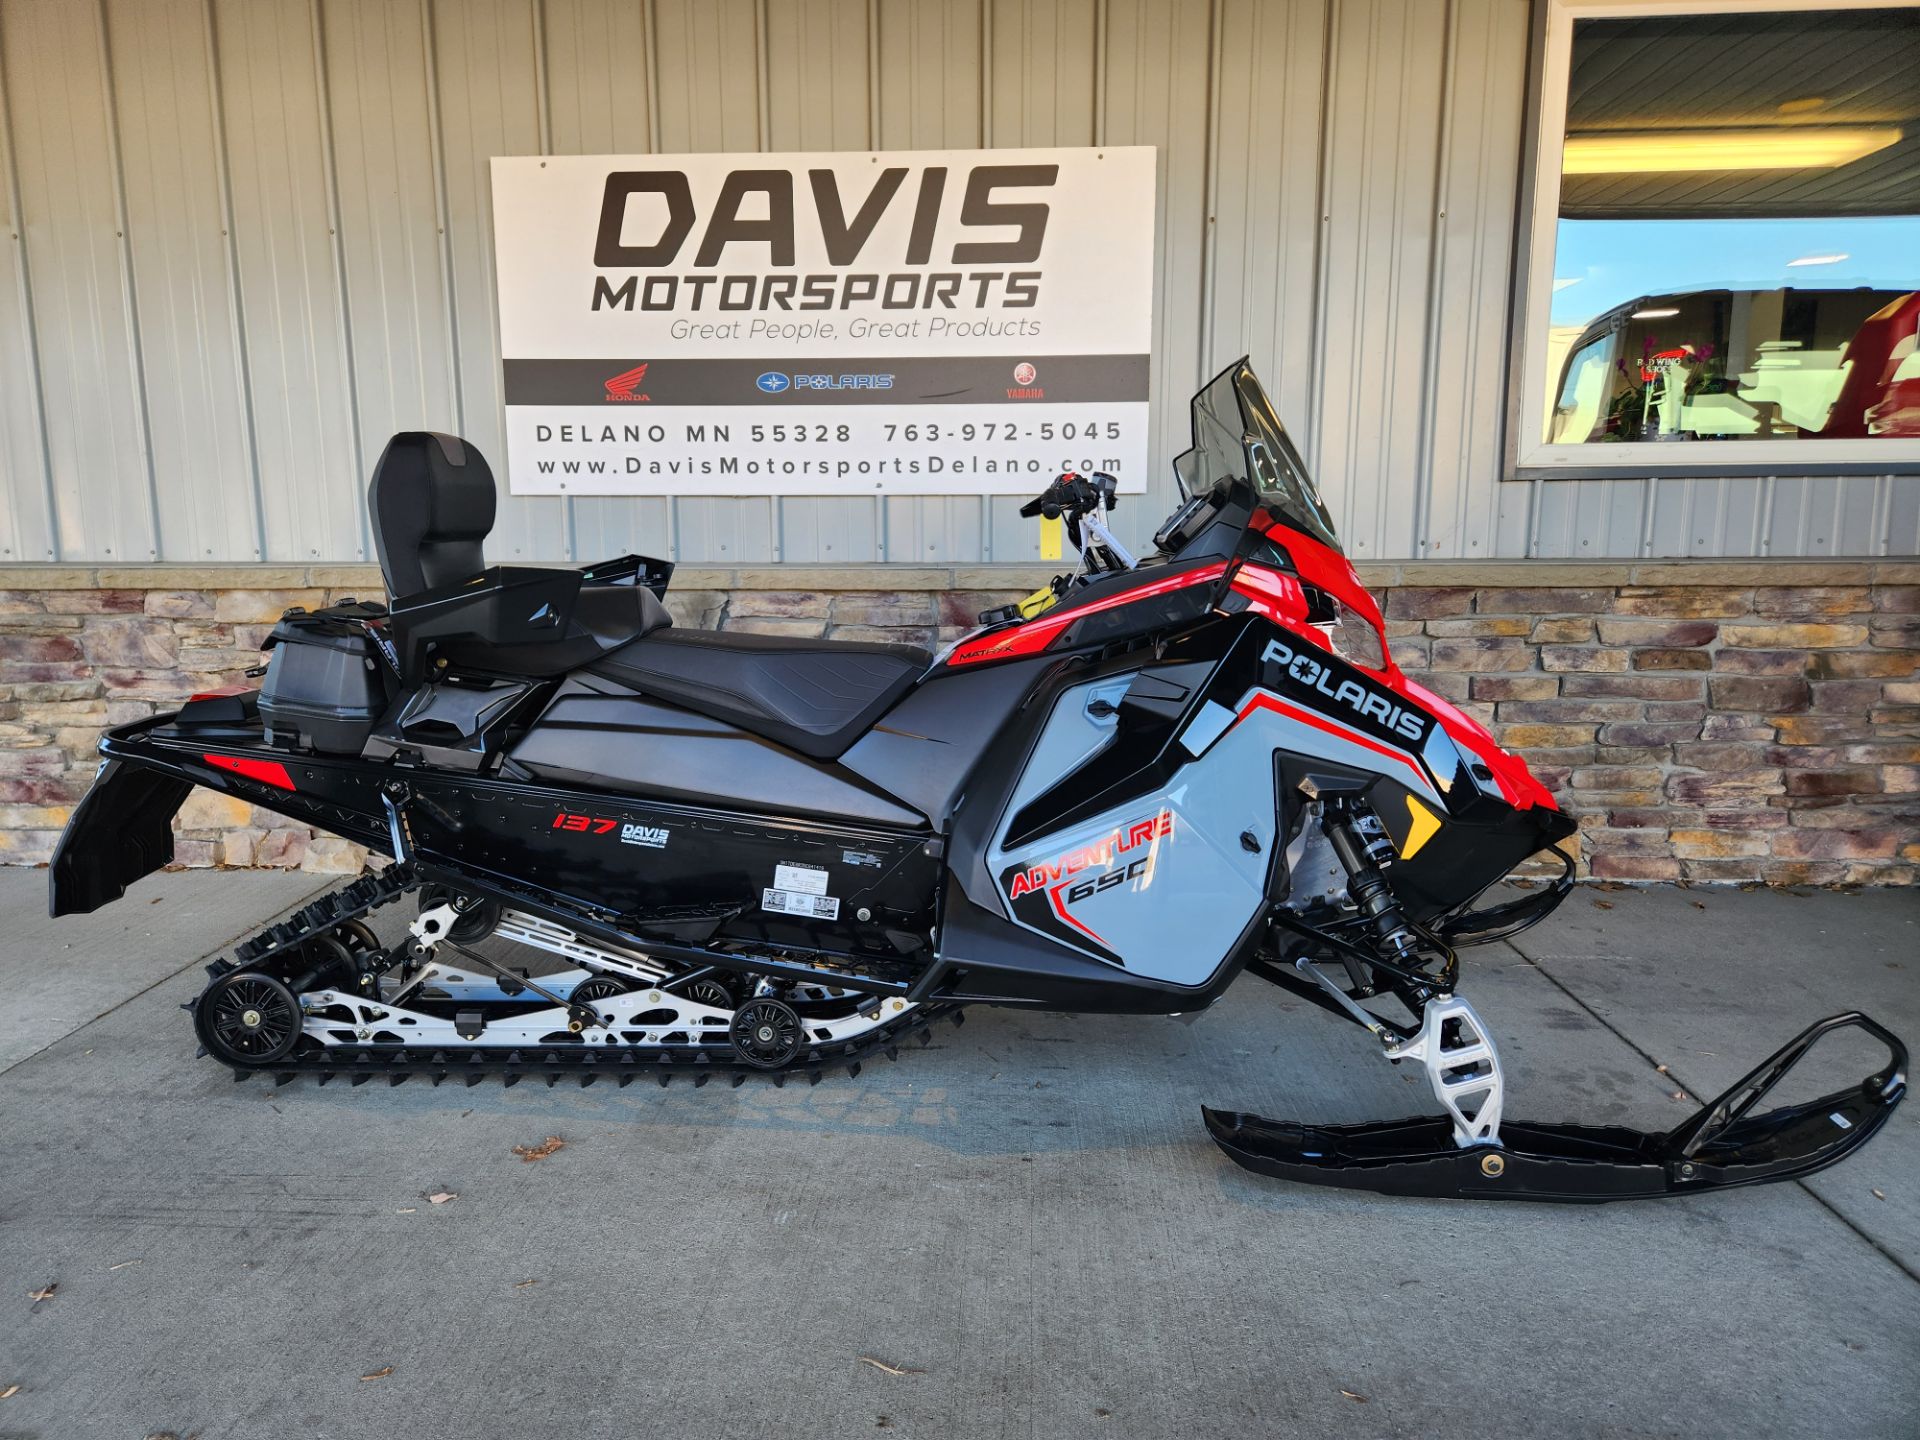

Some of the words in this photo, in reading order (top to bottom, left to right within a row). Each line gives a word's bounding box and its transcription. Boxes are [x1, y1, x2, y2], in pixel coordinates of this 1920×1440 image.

[593, 164, 1060, 268] DAVIS
[591, 271, 1043, 312] MOTORSPORTS
[670, 318, 742, 340] Great
[749, 318, 838, 344] People,
[849, 317, 921, 339] Great
[928, 316, 1041, 338] Products
[794, 374, 893, 390] POLARIS
[1007, 388, 1044, 400] YAMAHA
[536, 424, 665, 443] DELANO
[686, 424, 730, 443] MN
[751, 424, 851, 443] 55328
[883, 422, 1121, 442] 763-972-5045
[537, 455, 1121, 479] www.DavisMotorsportsDelano.com
[1260, 638, 1425, 741] POLARIS
[552, 813, 619, 835] 137
[621, 823, 670, 840] DAVIS
[1010, 811, 1173, 900] ADVENTURE
[1067, 857, 1153, 904] 650
